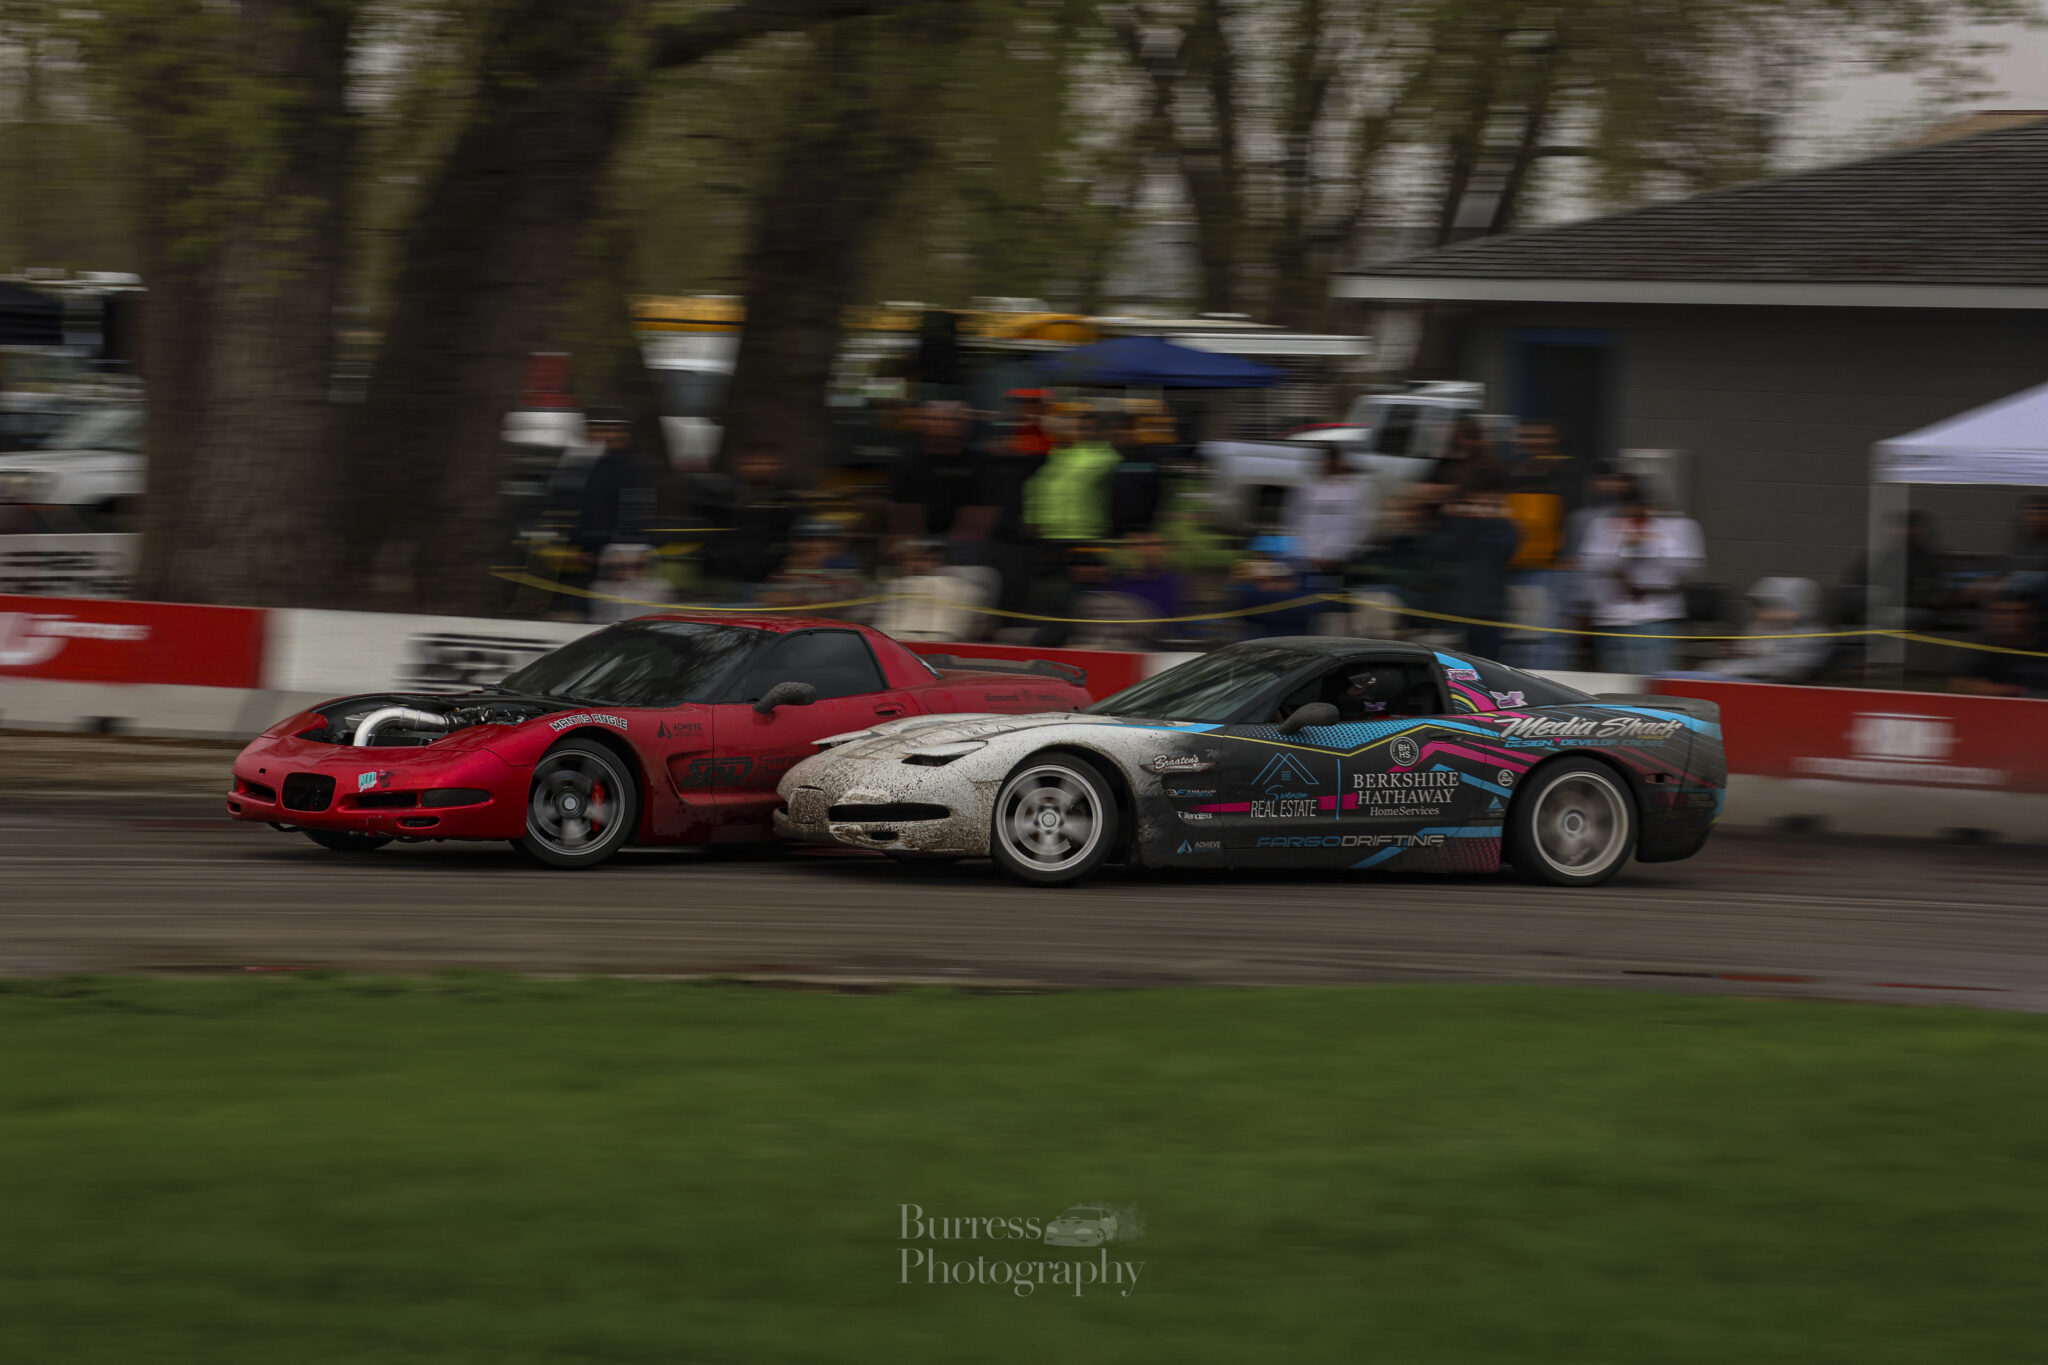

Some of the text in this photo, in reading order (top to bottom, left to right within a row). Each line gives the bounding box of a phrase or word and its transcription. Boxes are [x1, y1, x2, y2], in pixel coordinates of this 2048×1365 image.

[548, 713, 628, 732] MANTIS ANGLE
[673, 722, 703, 731] ACHIEVE
[1493, 716, 1684, 738] Media Shack
[1352, 771, 1460, 788] BERKSHIRE
[1357, 788, 1456, 805] HATHAWAY
[1250, 799, 1318, 818] REAL ESTATE
[1369, 806, 1440, 816] HomeServices
